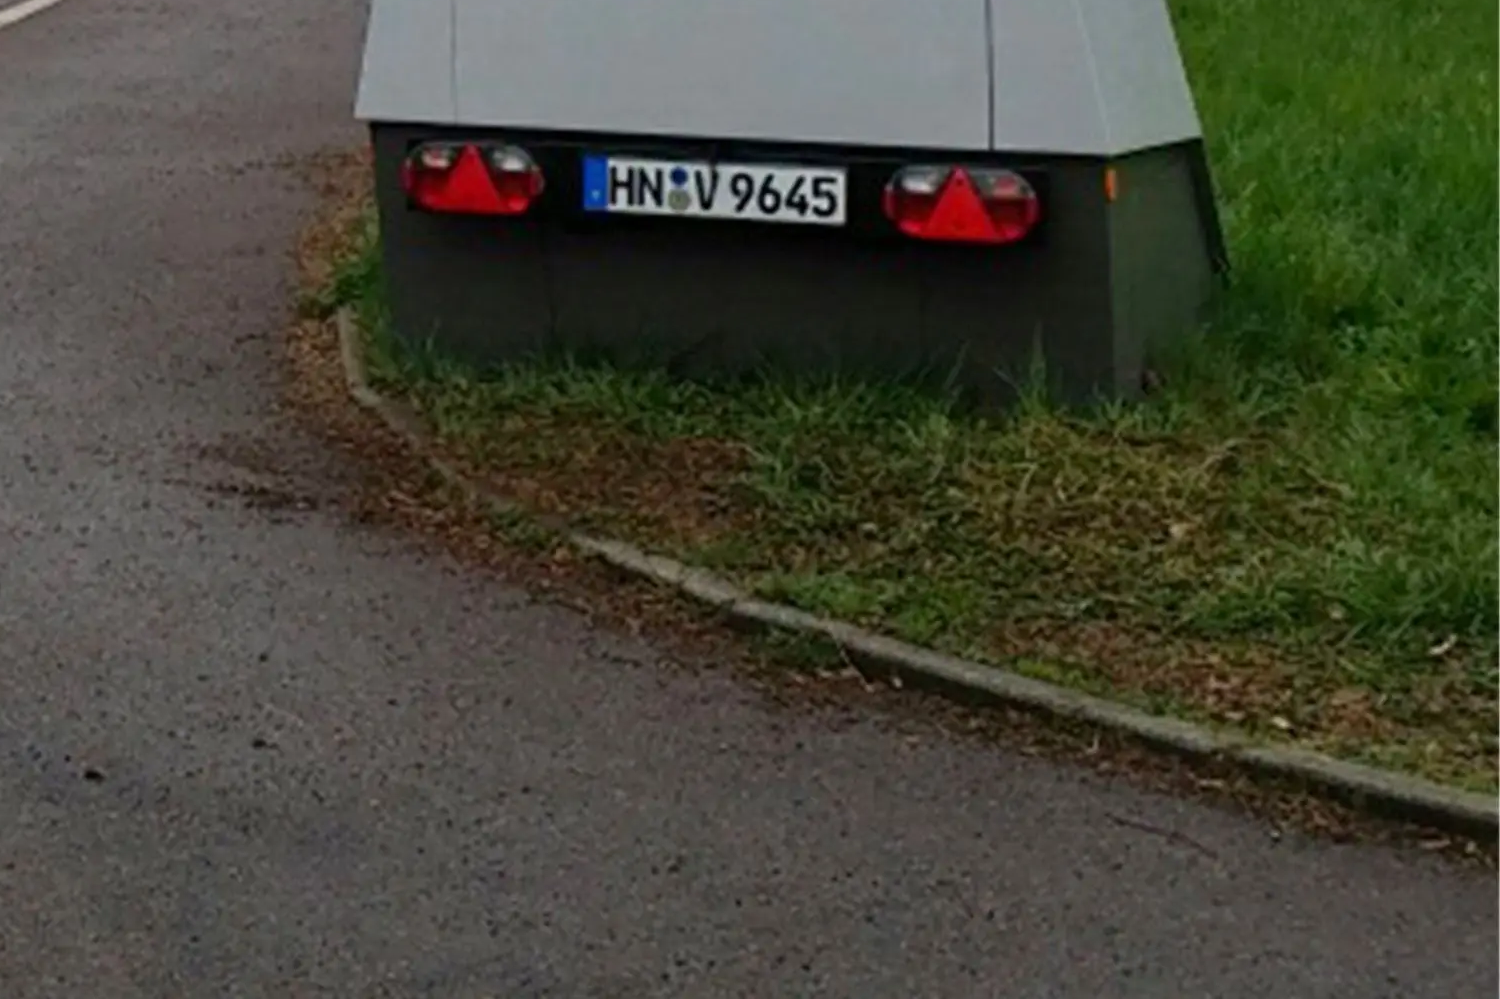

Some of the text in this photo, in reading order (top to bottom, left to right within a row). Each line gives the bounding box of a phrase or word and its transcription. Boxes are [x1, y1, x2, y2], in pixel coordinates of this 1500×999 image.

[609, 166, 838, 217] HN V 9645
